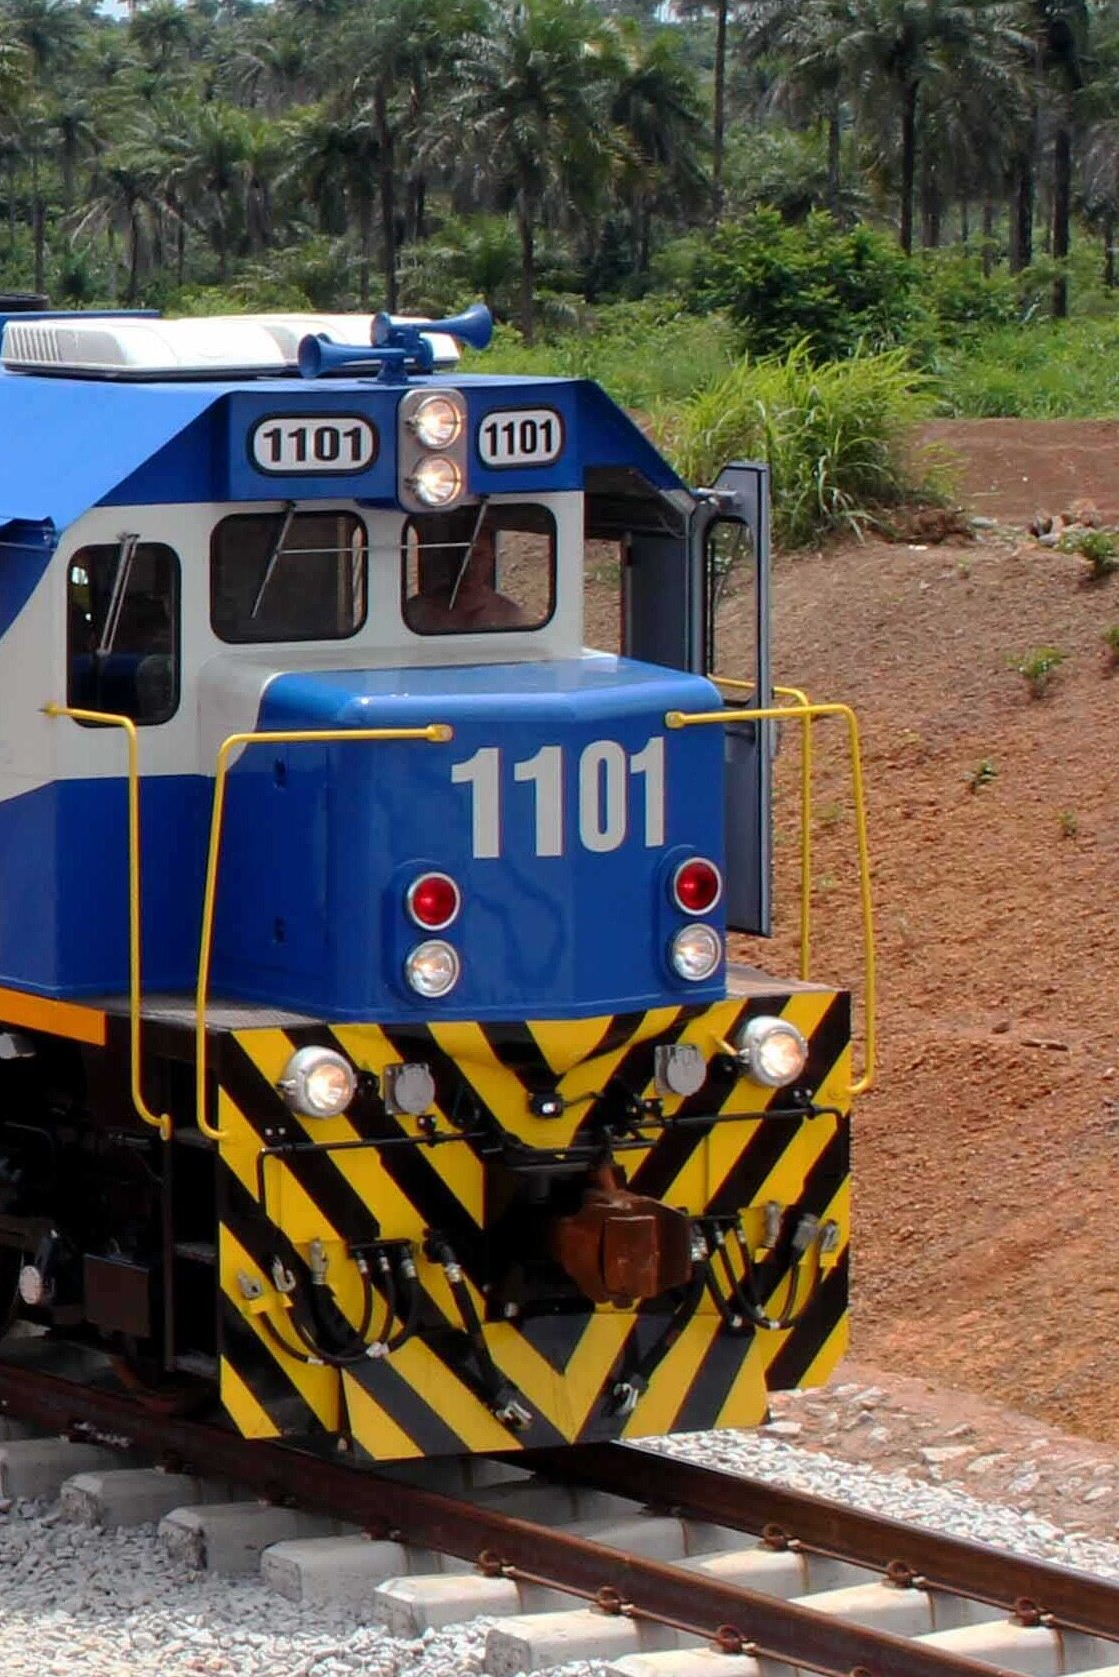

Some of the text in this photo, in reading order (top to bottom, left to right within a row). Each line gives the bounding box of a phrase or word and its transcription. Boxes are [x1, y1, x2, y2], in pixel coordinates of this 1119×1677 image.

[263, 426, 362, 462] 1101
[484, 419, 552, 457] 1101
[451, 736, 665, 859] 1101
